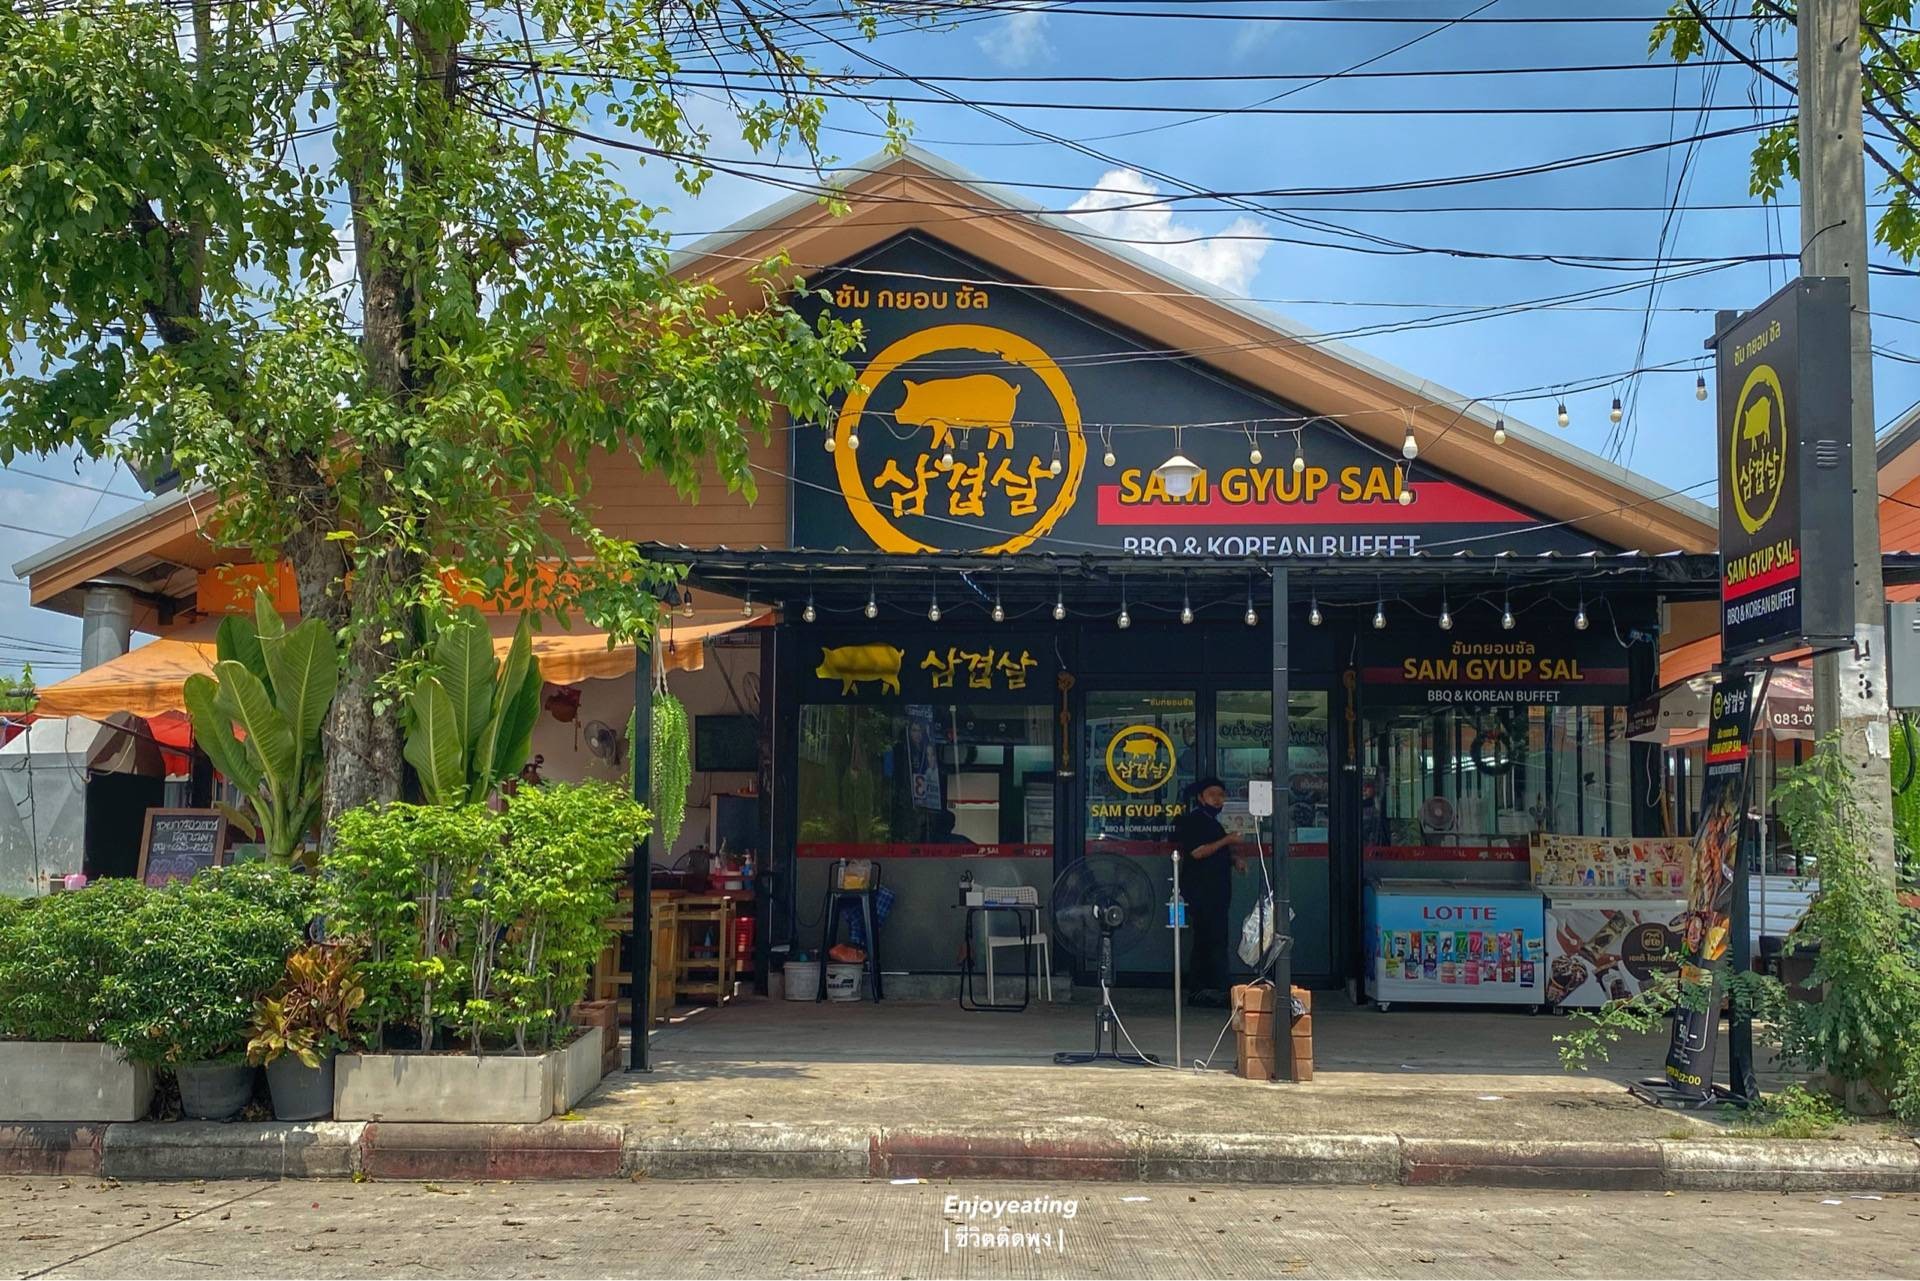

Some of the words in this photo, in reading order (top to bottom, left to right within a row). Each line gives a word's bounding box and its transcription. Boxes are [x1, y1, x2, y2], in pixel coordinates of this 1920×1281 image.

[836, 284, 870, 308] ซัม
[878, 290, 948, 309] กยอบ
[956, 285, 989, 309] ซัล
[874, 452, 1053, 518] 삼겹살
[1220, 467, 1329, 503] GYUP
[1740, 447, 1780, 502] 삼겹살
[1727, 557, 1747, 586] SAM
[1749, 546, 1774, 577] GYUP
[1776, 539, 1794, 568] SAL
[1727, 606, 1740, 625] BBQ
[1745, 595, 1770, 619] KOREAN
[1770, 588, 1796, 612] BUFFET
[920, 646, 1038, 690] 삼겹살
[1403, 658, 1458, 681] SAM
[1466, 658, 1532, 681] GYUP
[1539, 658, 1584, 681] SAL
[1427, 690, 1452, 703] BBQ
[1454, 691, 1463, 702] &
[1465, 690, 1514, 702] KOREAN
[1516, 690, 1561, 703] BUFFET
[1774, 713, 1814, 726] 083-0
[1116, 760, 1167, 779] 삼겹살
[1091, 804, 1122, 817] SAM
[1125, 804, 1162, 817] GYUP
[1165, 804, 1186, 817] SA
[1423, 906, 1498, 921] LOTTE
